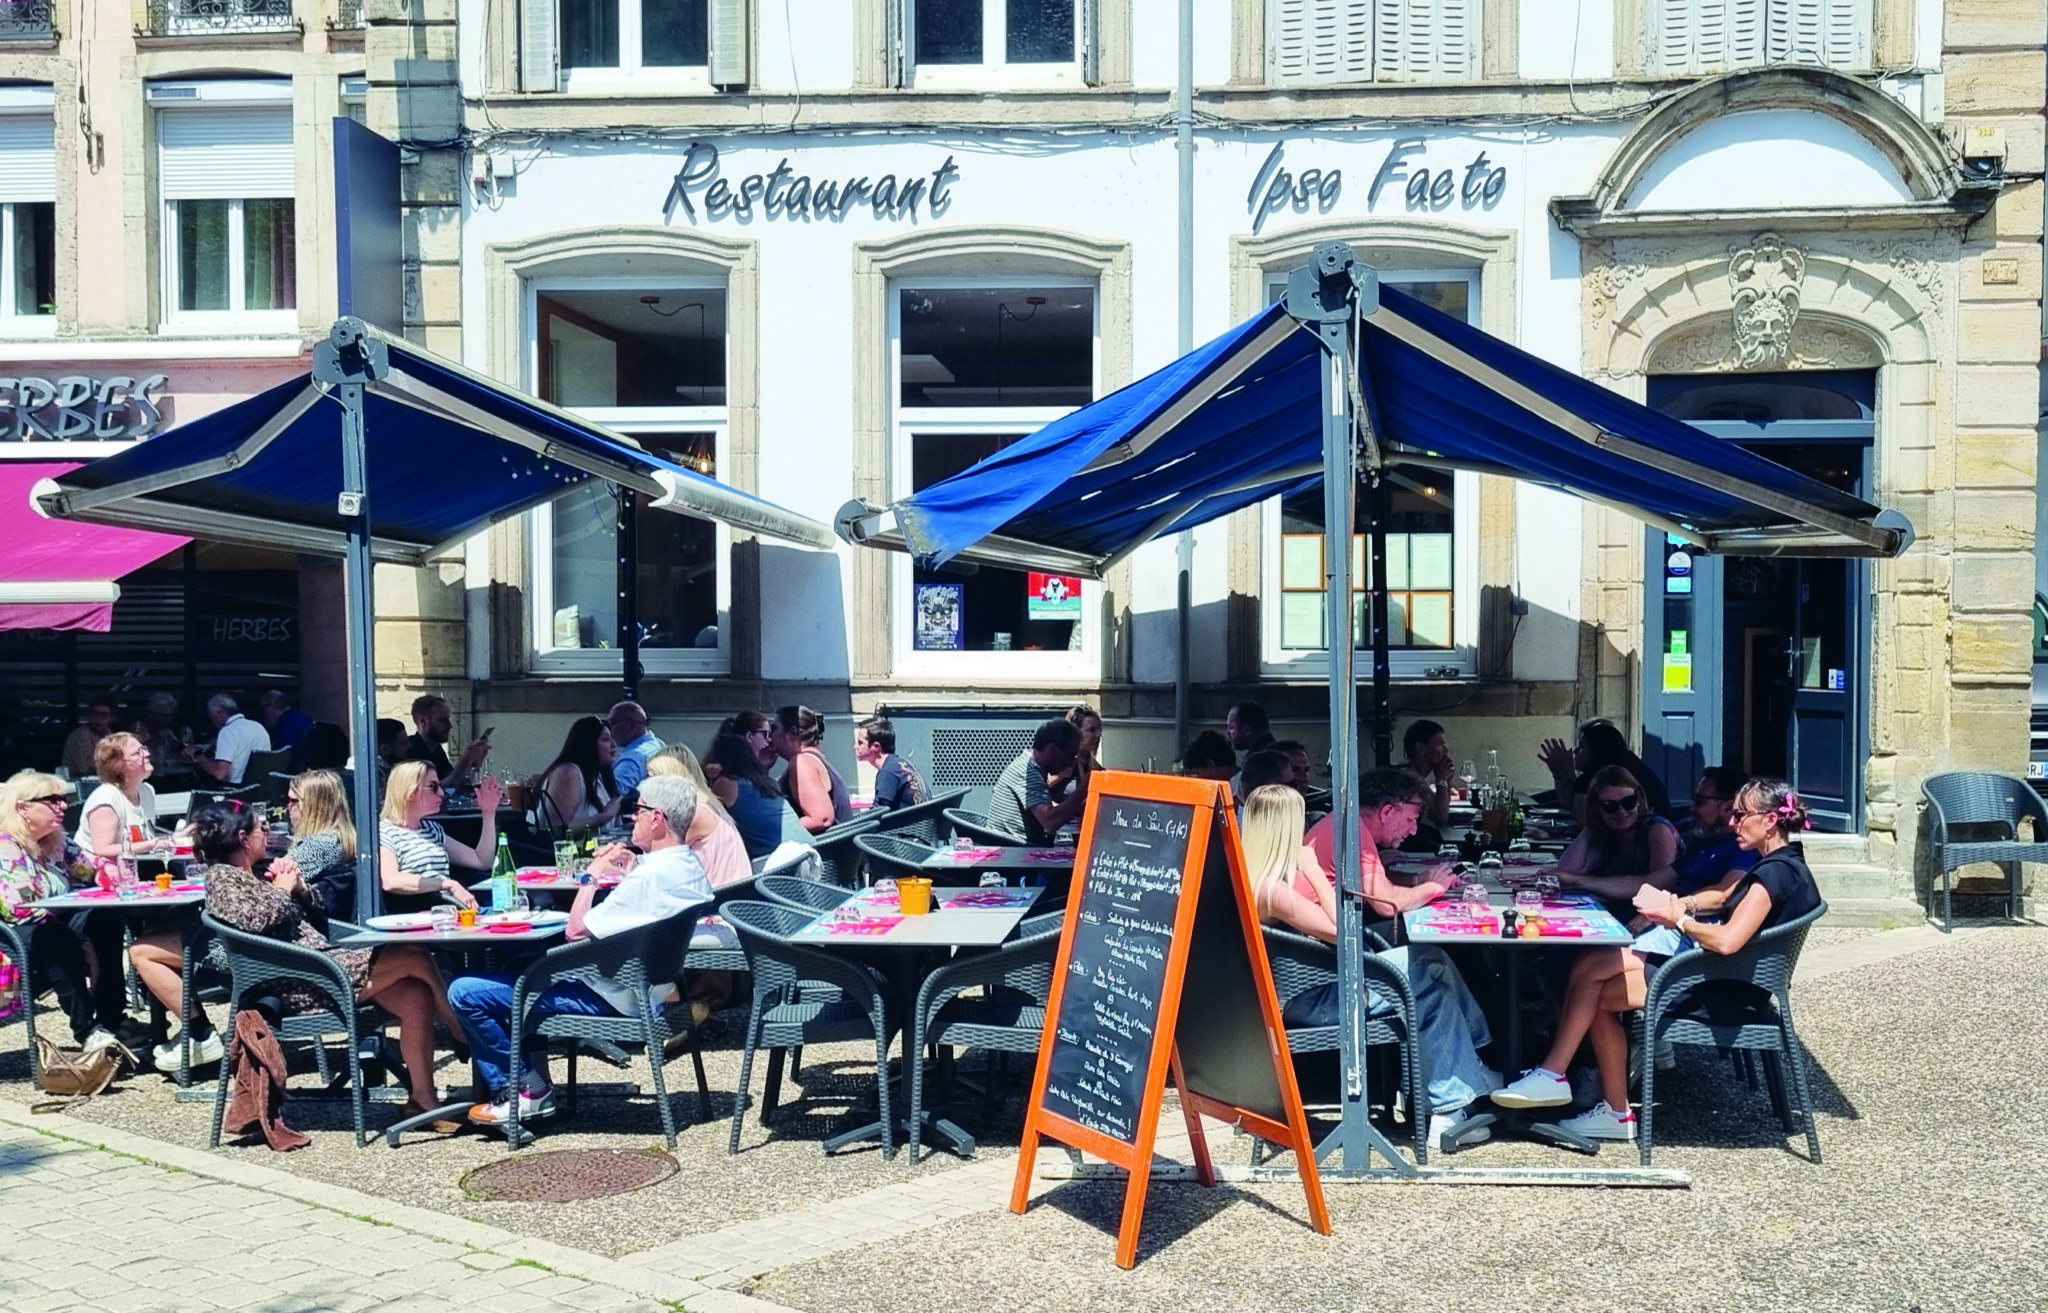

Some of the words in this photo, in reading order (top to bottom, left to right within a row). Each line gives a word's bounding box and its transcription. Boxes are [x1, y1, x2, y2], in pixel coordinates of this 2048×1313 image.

[662, 142, 958, 214] Restaurant
[1247, 139, 1341, 233] Ipso
[1367, 137, 1506, 204] Facto
[213, 618, 291, 642] HERBES
[2030, 765, 2044, 776] RJ
